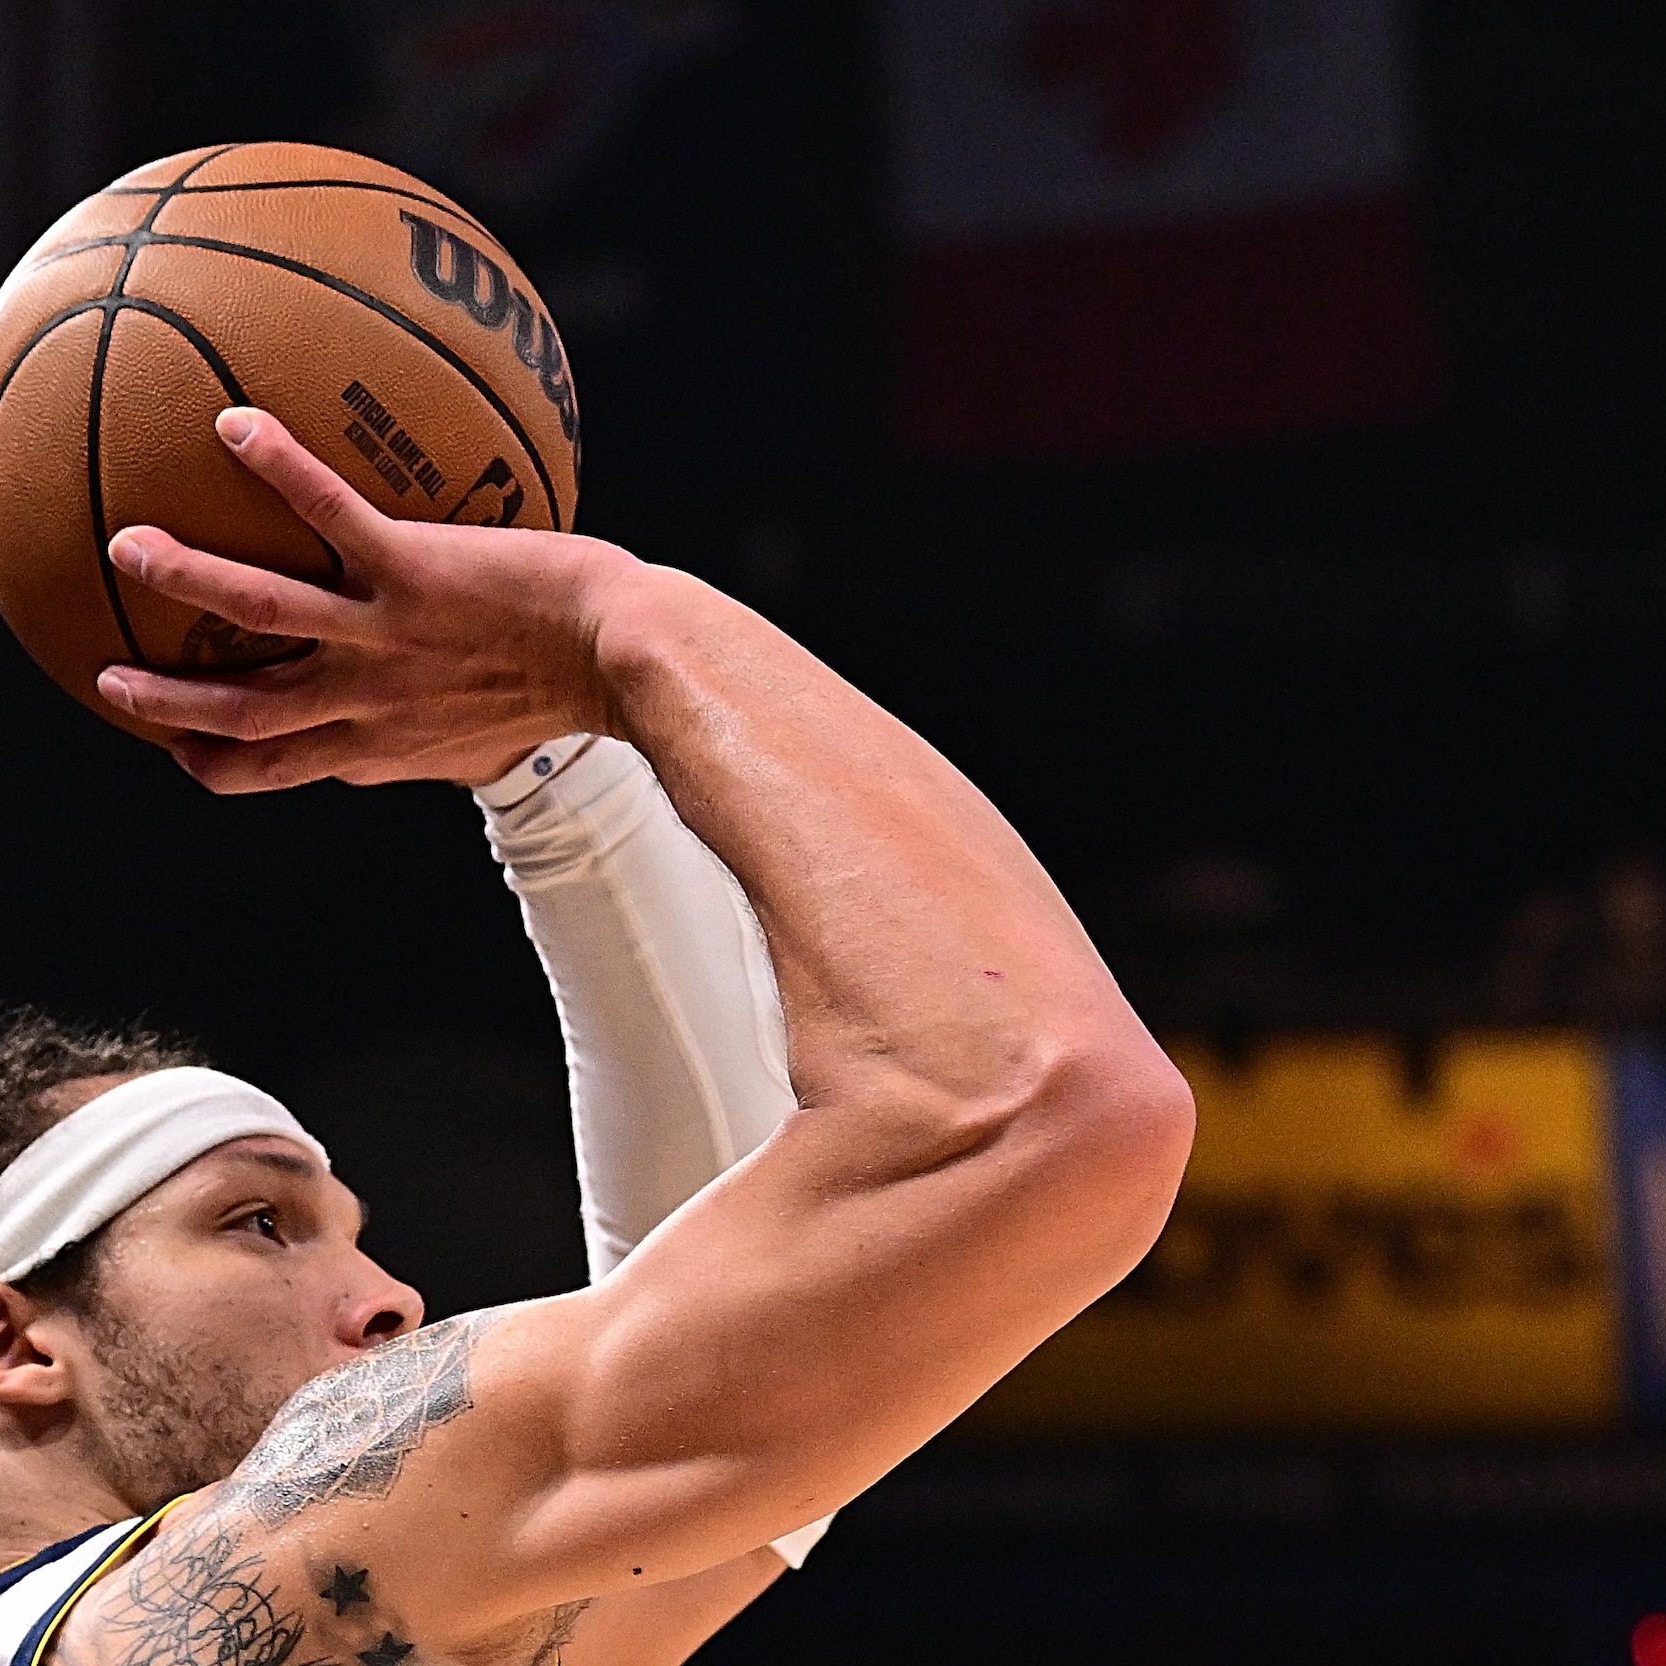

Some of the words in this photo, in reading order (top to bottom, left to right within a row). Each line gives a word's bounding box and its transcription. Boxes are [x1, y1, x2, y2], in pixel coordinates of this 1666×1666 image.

[341, 380, 397, 440] OFFICIAL
[387, 429, 425, 473] GAME
[414, 460, 446, 501] BALL
